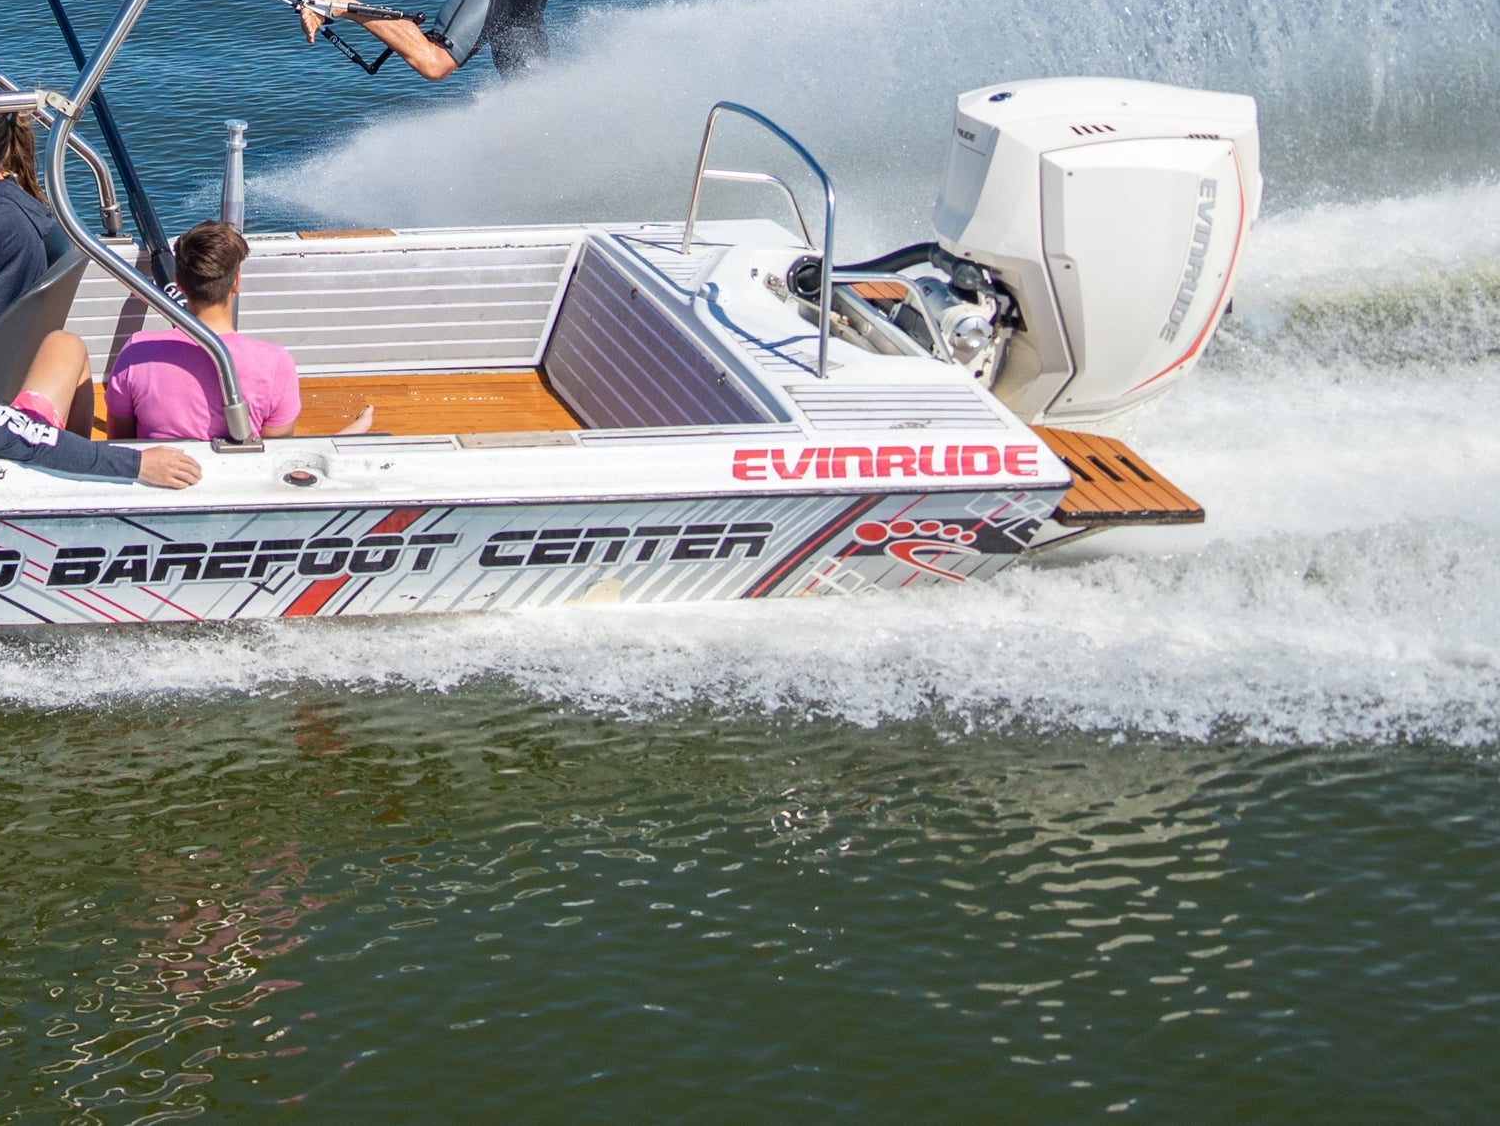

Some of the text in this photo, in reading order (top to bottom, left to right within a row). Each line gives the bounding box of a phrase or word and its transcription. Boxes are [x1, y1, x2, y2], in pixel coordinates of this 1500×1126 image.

[1159, 178, 1217, 344] EVINRUDE
[732, 445, 1039, 481] EVINRUDE
[44, 531, 464, 590] BAREFOOT
[478, 521, 776, 570] CENTER
